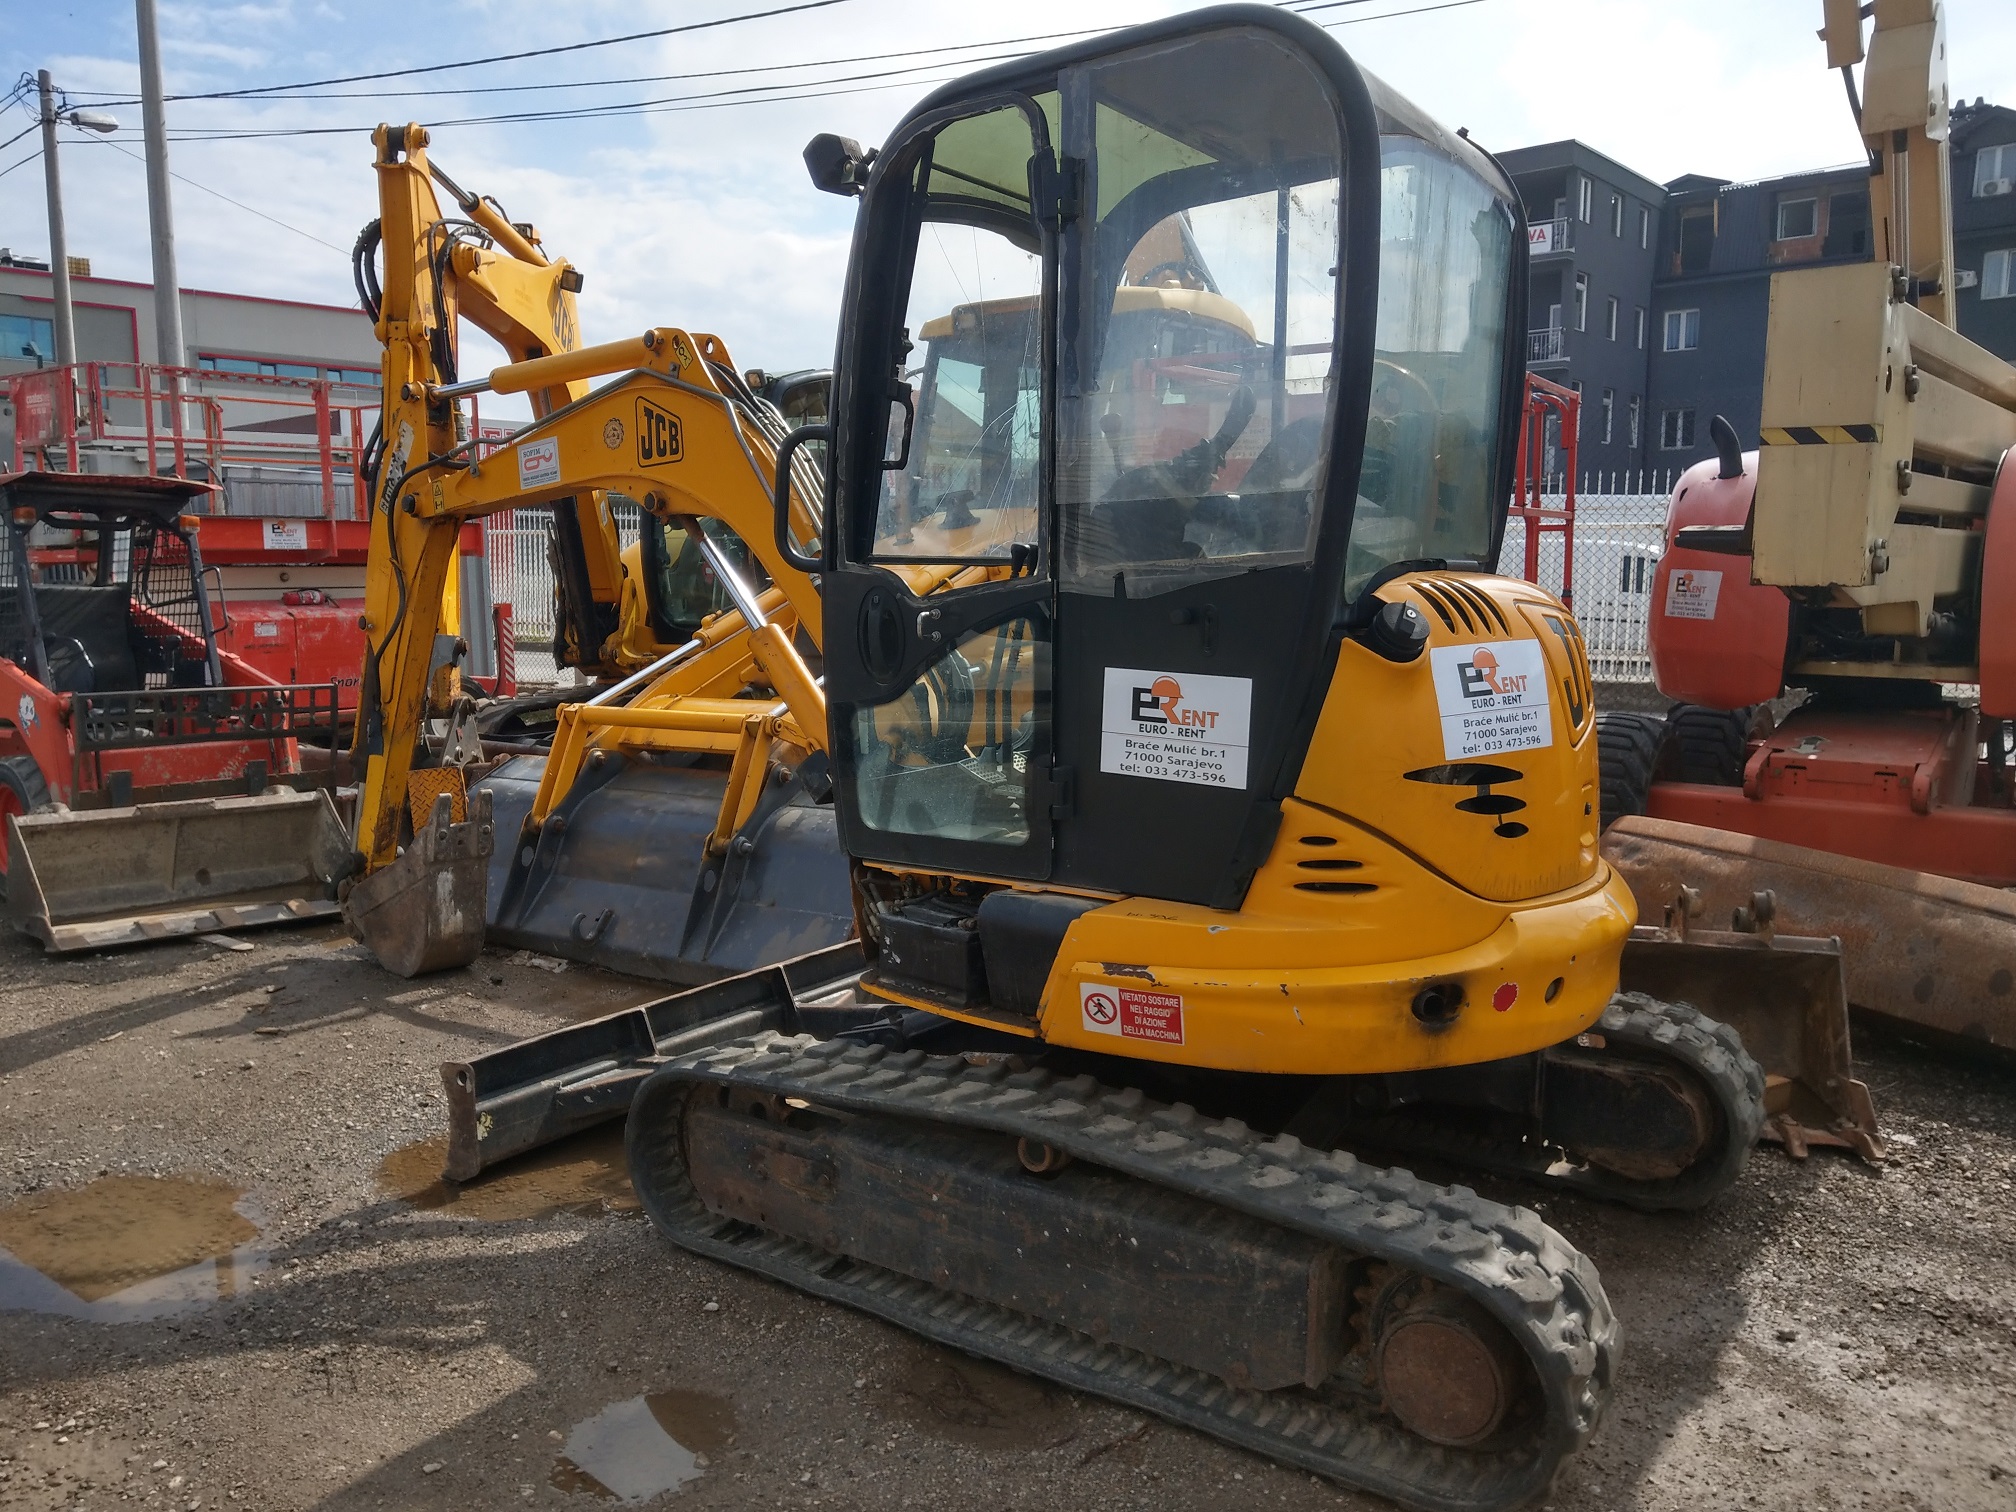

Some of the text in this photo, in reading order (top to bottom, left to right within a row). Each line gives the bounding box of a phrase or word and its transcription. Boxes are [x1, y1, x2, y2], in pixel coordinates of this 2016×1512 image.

[641, 406, 679, 460] JCB
[1472, 697, 1495, 709] EURO
[1502, 695, 1522, 706] RENT
[1463, 716, 1492, 728] Braće
[1495, 712, 1520, 724] Mulić
[1139, 723, 1167, 735] EURO
[1178, 727, 1206, 738] RENT
[1465, 724, 1537, 741] 71000 Sarajevo
[1125, 739, 1159, 751] Braće
[1163, 743, 1197, 755] Mulić
[1462, 735, 1541, 754] tel: 033 473-596
[1125, 751, 1222, 770] 71000 Sarajevo
[1120, 763, 1226, 783] tel: 033 473-596
[1120, 991, 1179, 1007] VIETATO SOSTARE
[1130, 1004, 1170, 1018] NEL RAGGIO
[1134, 1016, 1167, 1028] DI AZIONE
[1123, 1025, 1180, 1040] DELLA MACCHINA
